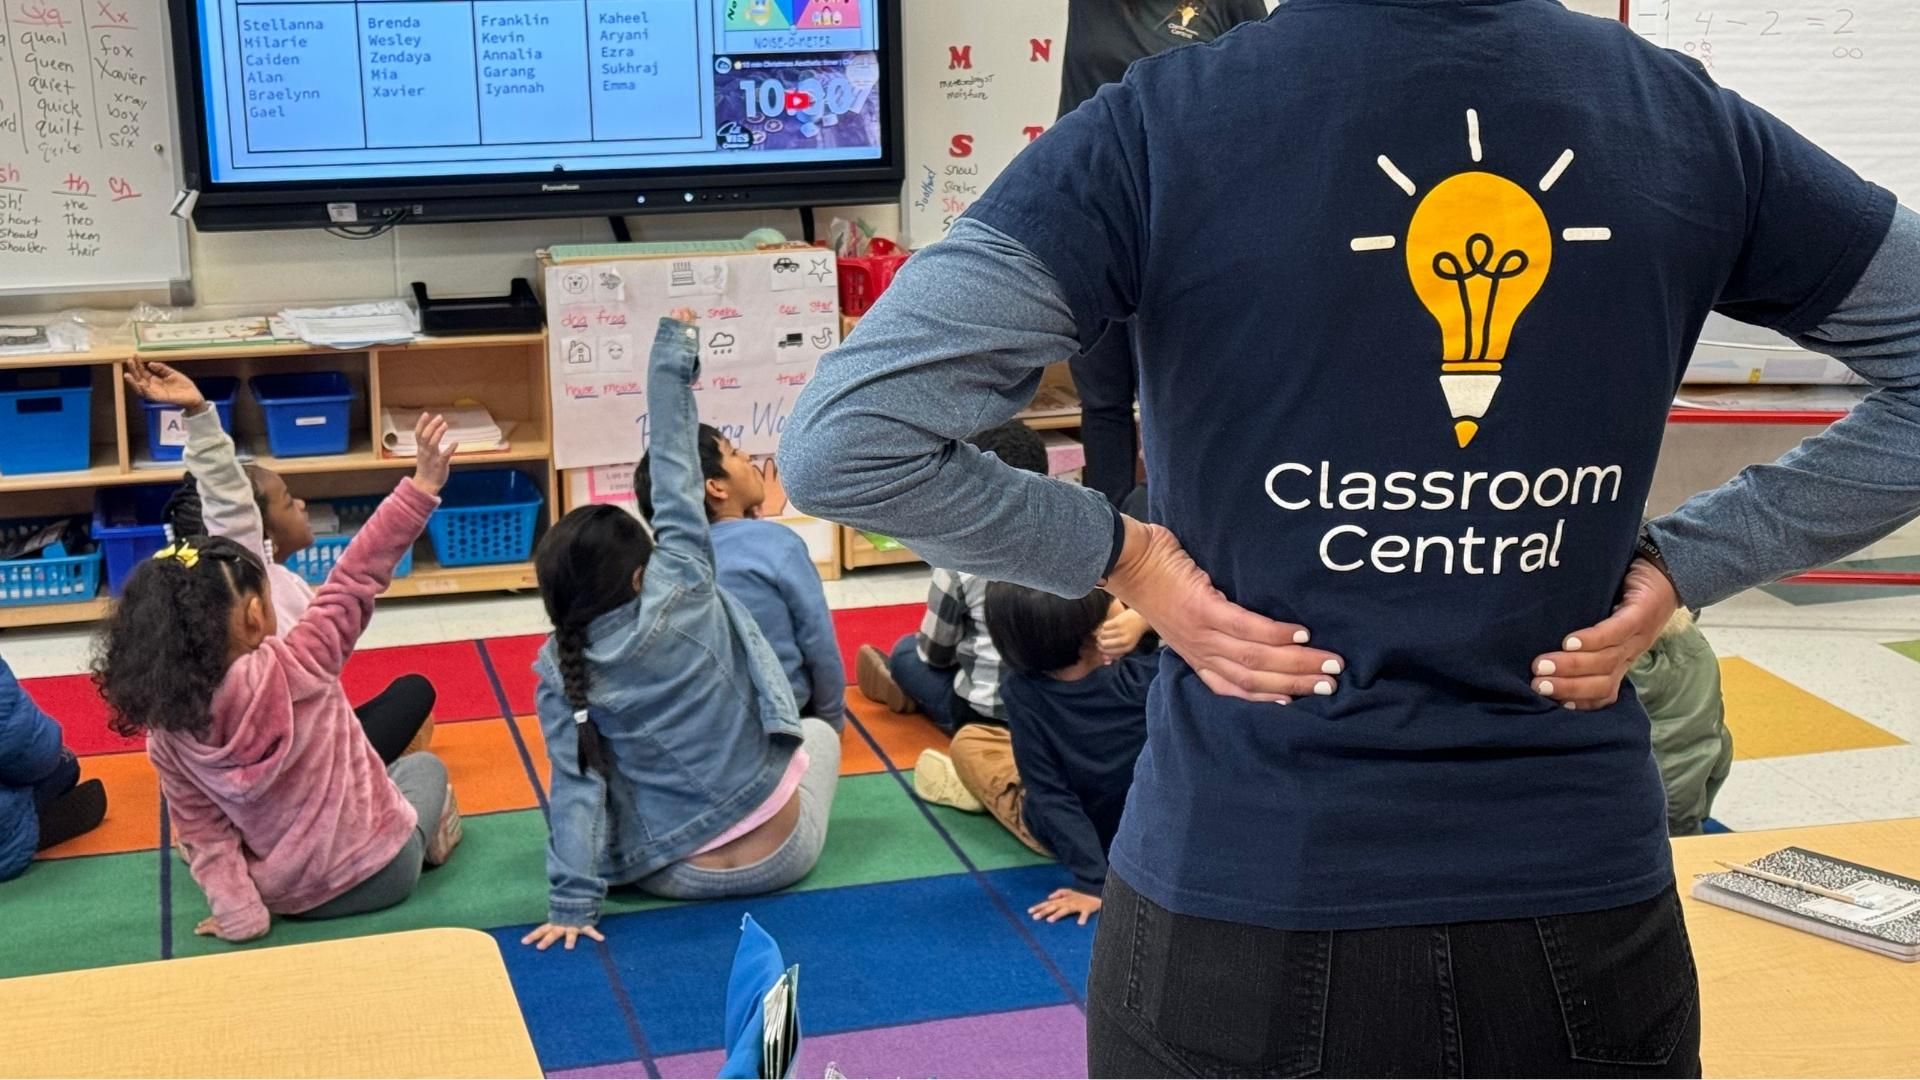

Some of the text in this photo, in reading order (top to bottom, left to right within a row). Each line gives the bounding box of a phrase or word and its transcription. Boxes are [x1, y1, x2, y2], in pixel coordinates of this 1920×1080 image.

[243, 18, 324, 32] Stellanna
[368, 16, 421, 29] Brenda
[481, 13, 550, 27] Franklin
[599, 11, 649, 24] Kaheel
[1760, 11, 1781, 35] 2
[1833, 9, 1854, 34] 2
[20, 31, 67, 52] quail
[368, 33, 422, 48] Wesley
[482, 32, 525, 44] Kevin
[600, 28, 649, 44] Aryani
[753, 35, 832, 49] NOISE-O-METER
[100, 34, 134, 57] fox
[601, 46, 634, 58] Ezra
[246, 53, 301, 67] Caiden
[370, 51, 432, 65] Zendaya
[483, 49, 543, 61] Annalia
[949, 38, 1052, 69] M N
[24, 52, 75, 76] queen
[93, 57, 147, 86] Xavier
[601, 60, 658, 76] Sukhraj
[247, 71, 284, 84] Alan
[371, 69, 399, 81] Mia
[483, 66, 536, 80] Garang
[28, 76, 76, 95] quiet
[373, 85, 425, 98] Xavier
[485, 82, 545, 97] Iyannah
[603, 80, 636, 91] Emma
[248, 87, 321, 103] Braelynn
[37, 98, 83, 119] quick
[107, 103, 139, 122] box
[249, 105, 286, 118] Gael
[35, 118, 85, 138] quilt
[120, 125, 140, 137] ox
[949, 134, 974, 158] S
[62, 172, 90, 197] th
[1264, 460, 1623, 511] Classroom
[1318, 518, 1566, 575] Central
